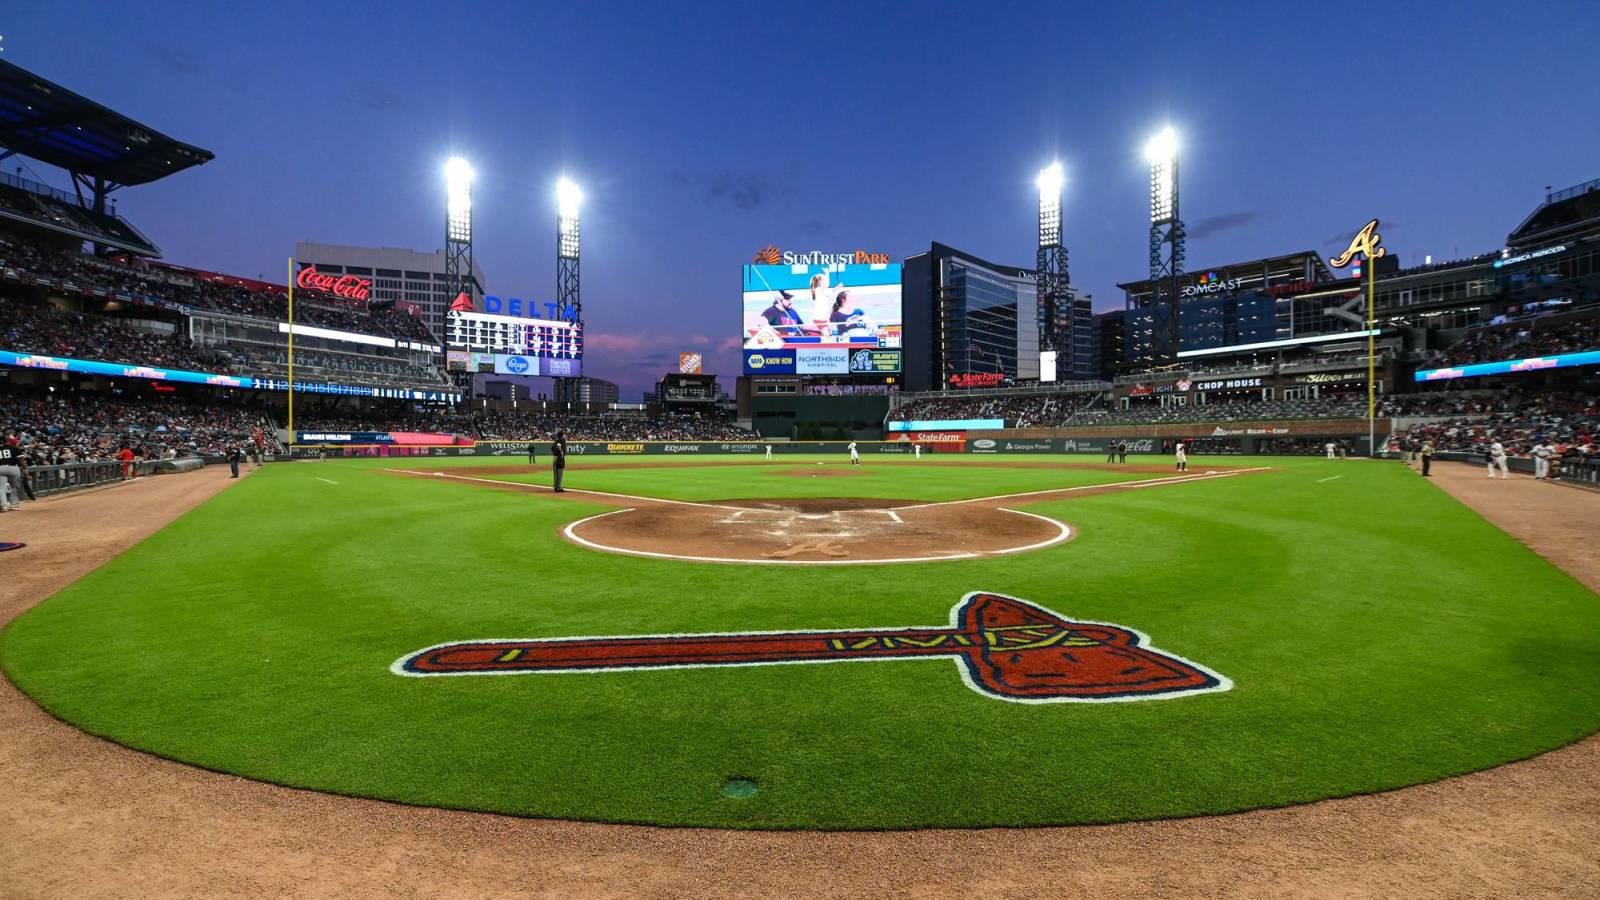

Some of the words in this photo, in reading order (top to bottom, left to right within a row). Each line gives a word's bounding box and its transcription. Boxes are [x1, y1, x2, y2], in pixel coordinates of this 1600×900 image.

[855, 250, 889, 264] PARK
[297, 265, 371, 300] Coca-Cola
[485, 295, 577, 321] DELTA
[508, 358, 527, 372] Kroger
[962, 372, 982, 381] State
[983, 372, 1005, 381] Farm
[1306, 373, 1342, 383] Silver
[1198, 381, 1224, 390] CHOP
[1226, 378, 1262, 388] HOUSE
[917, 433, 939, 441] State
[939, 433, 960, 441] Farm
[607, 443, 645, 451] QUIKRETE
